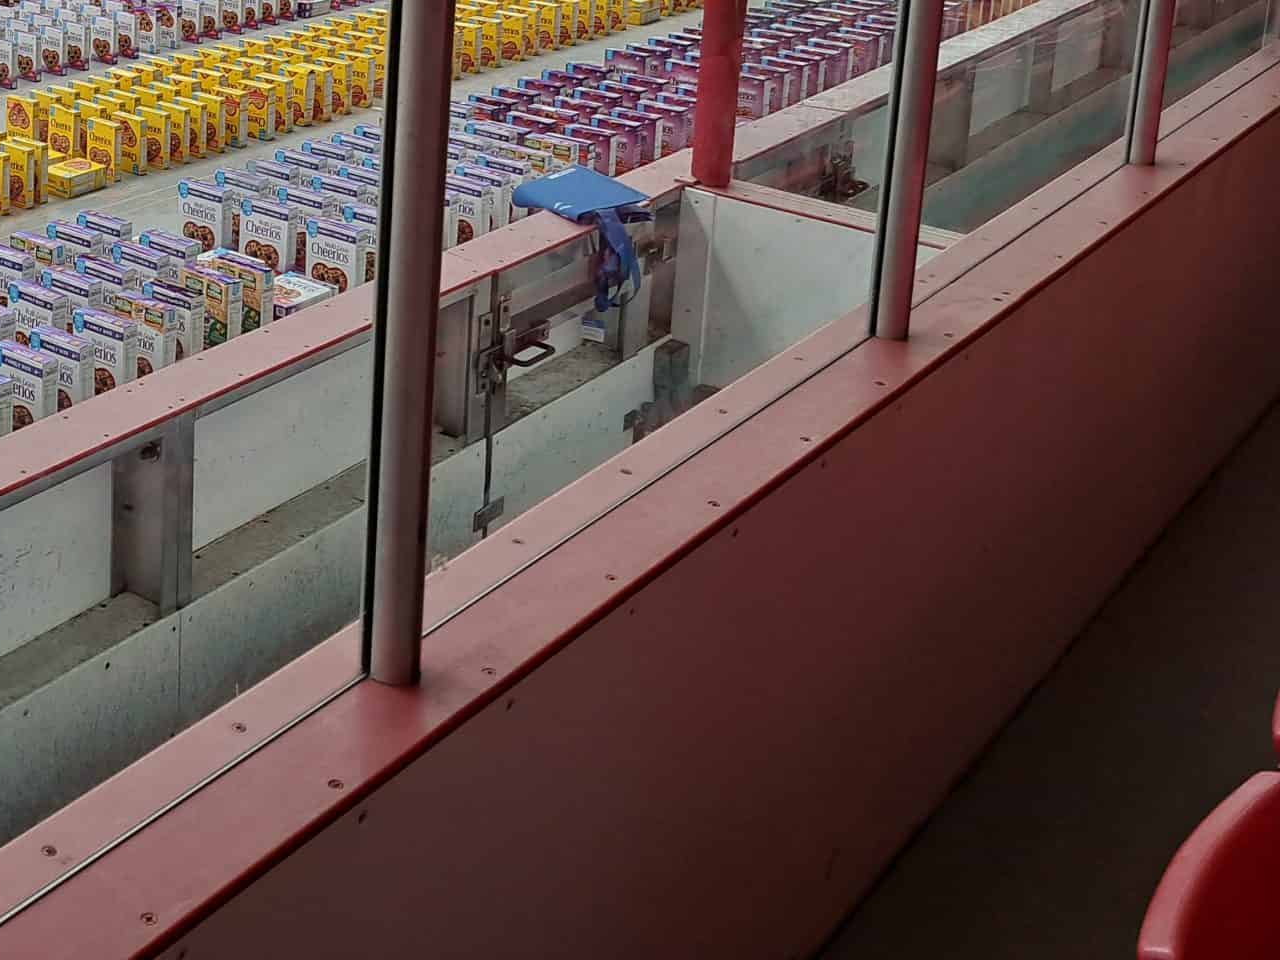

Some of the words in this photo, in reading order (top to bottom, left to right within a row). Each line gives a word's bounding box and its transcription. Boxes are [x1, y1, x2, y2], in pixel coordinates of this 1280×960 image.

[182, 202, 217, 222] Cheerios
[245, 219, 281, 241] Cheerios
[311, 242, 350, 264] Cheerios
[94, 347, 117, 365] erios
[13, 383, 35, 402] erios
